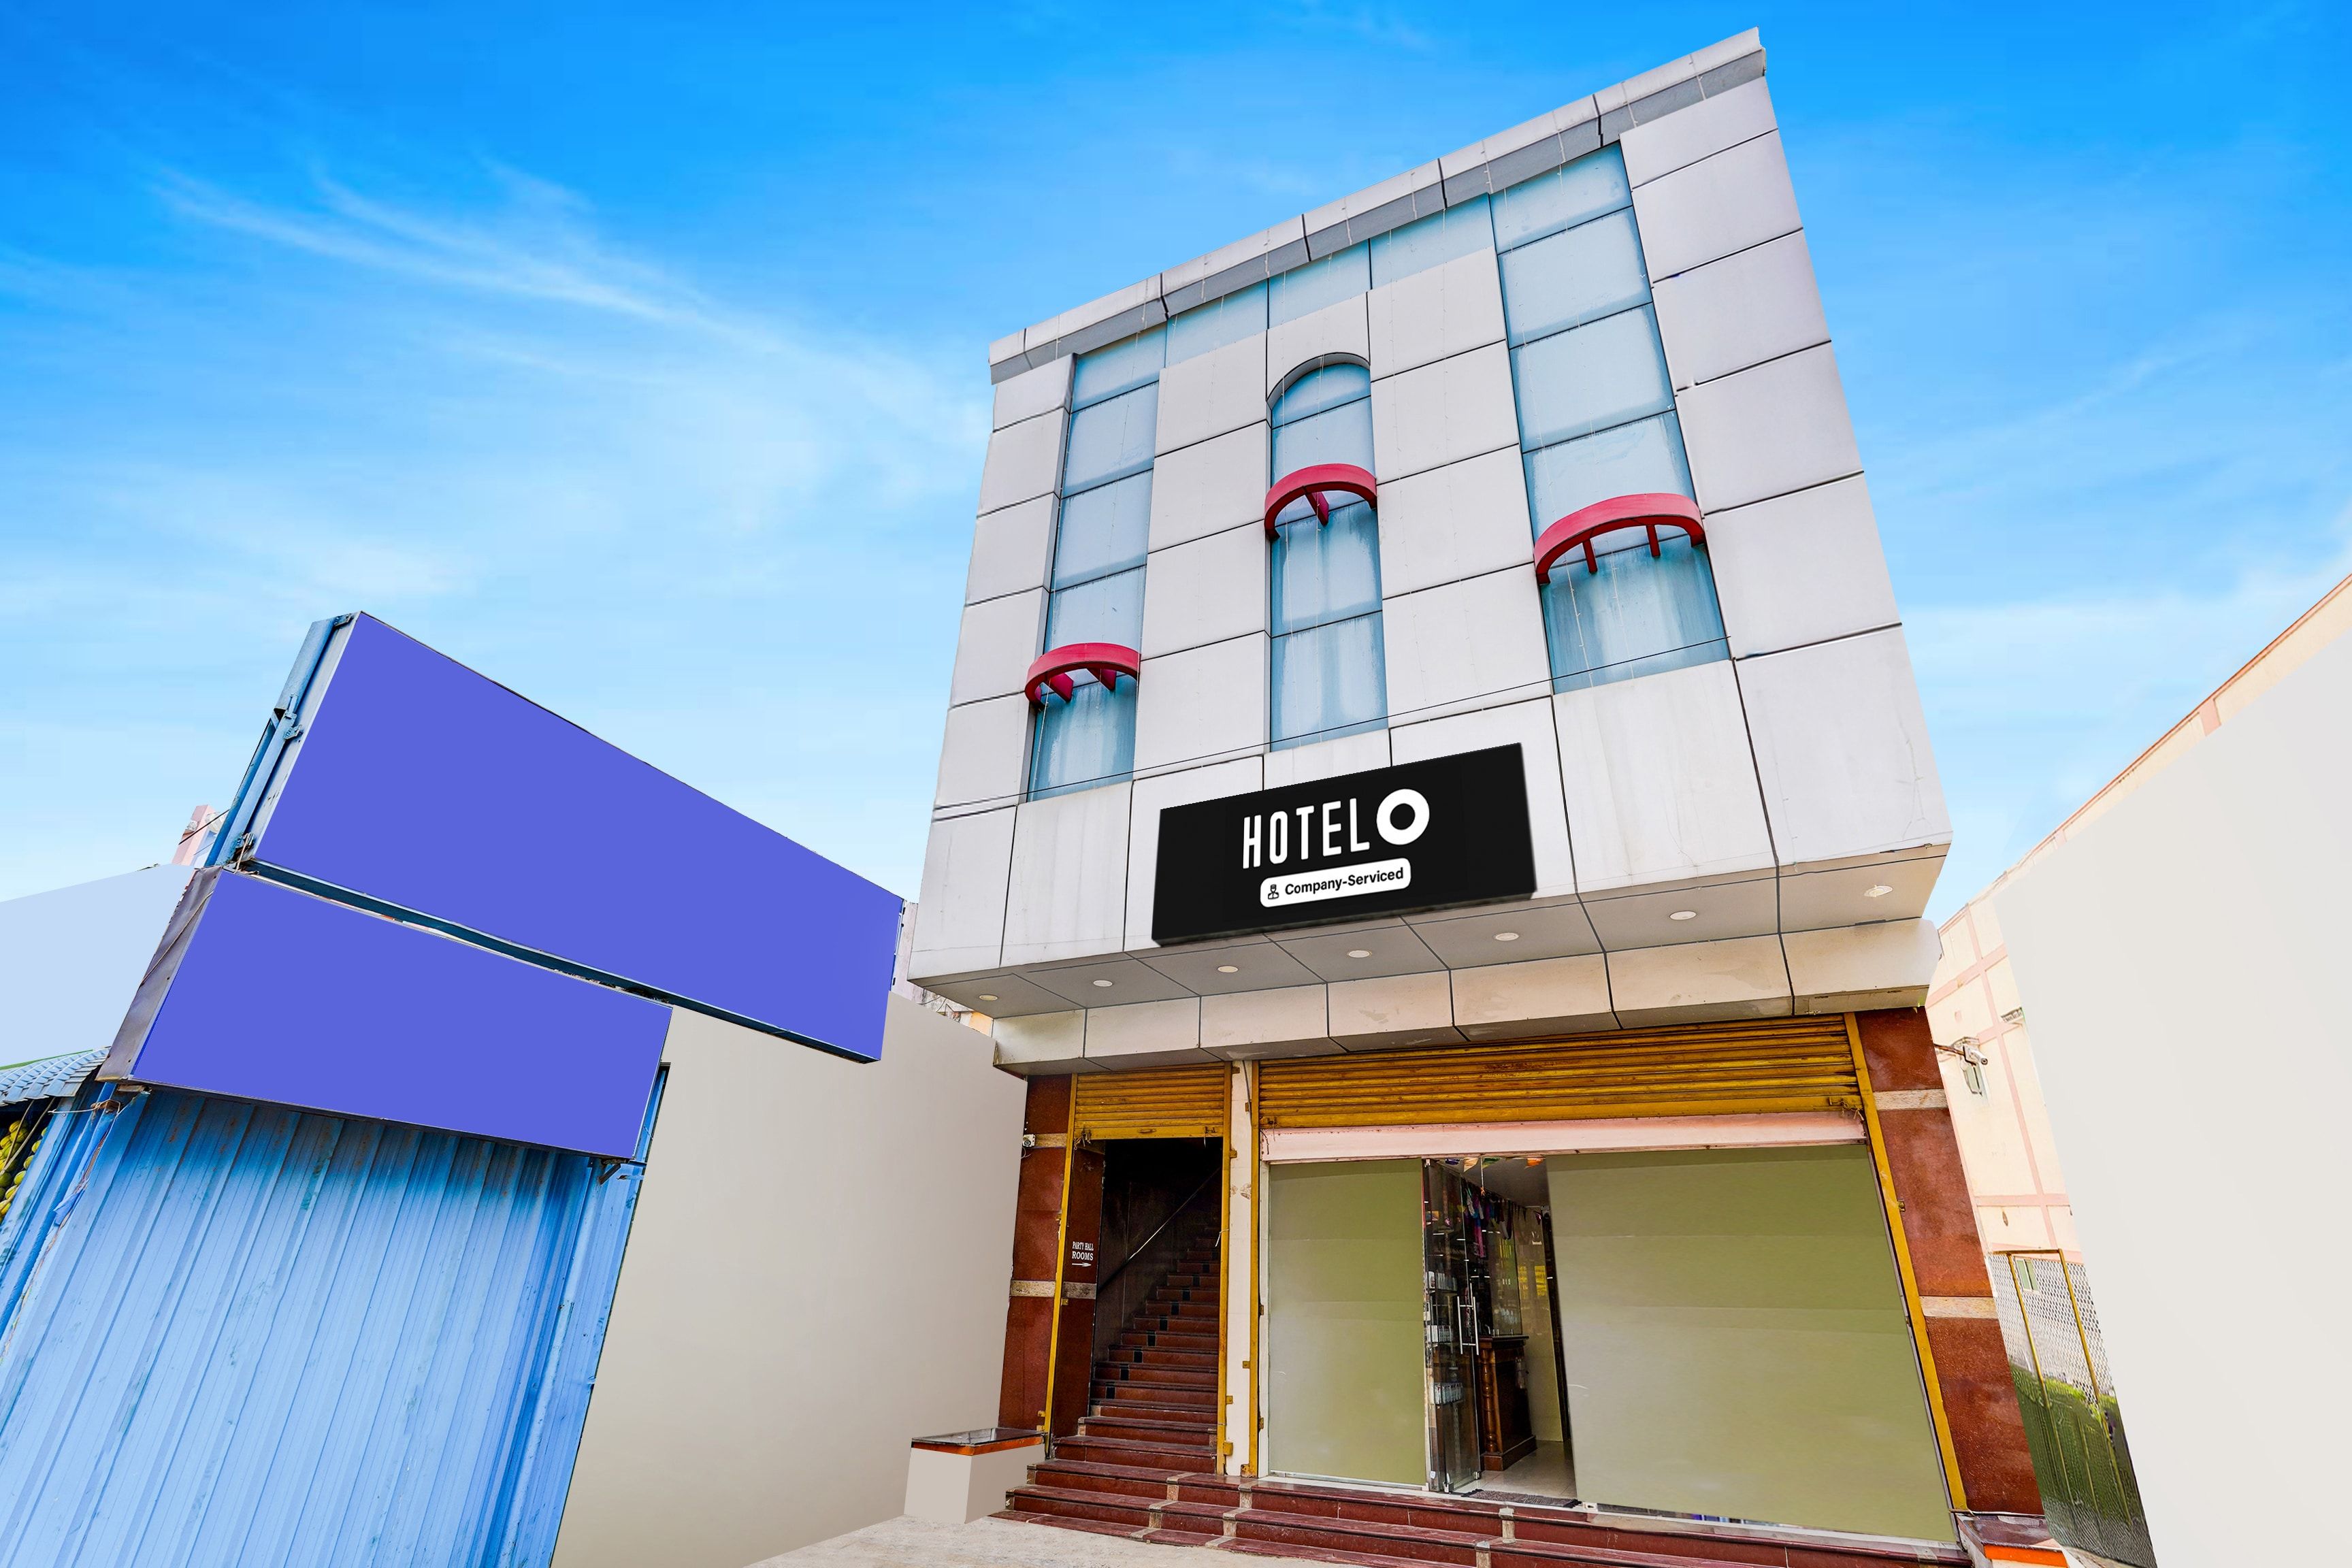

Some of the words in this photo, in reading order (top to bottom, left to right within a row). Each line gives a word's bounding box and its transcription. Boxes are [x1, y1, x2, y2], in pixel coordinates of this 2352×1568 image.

[1243, 798, 1370, 869] HOTEL
[1284, 866, 1404, 897] Company-Serviced
[1071, 1251, 1094, 1261] ROOMS
[1072, 1241, 1084, 1250] PARTY
[1085, 1242, 1094, 1251] HALL
